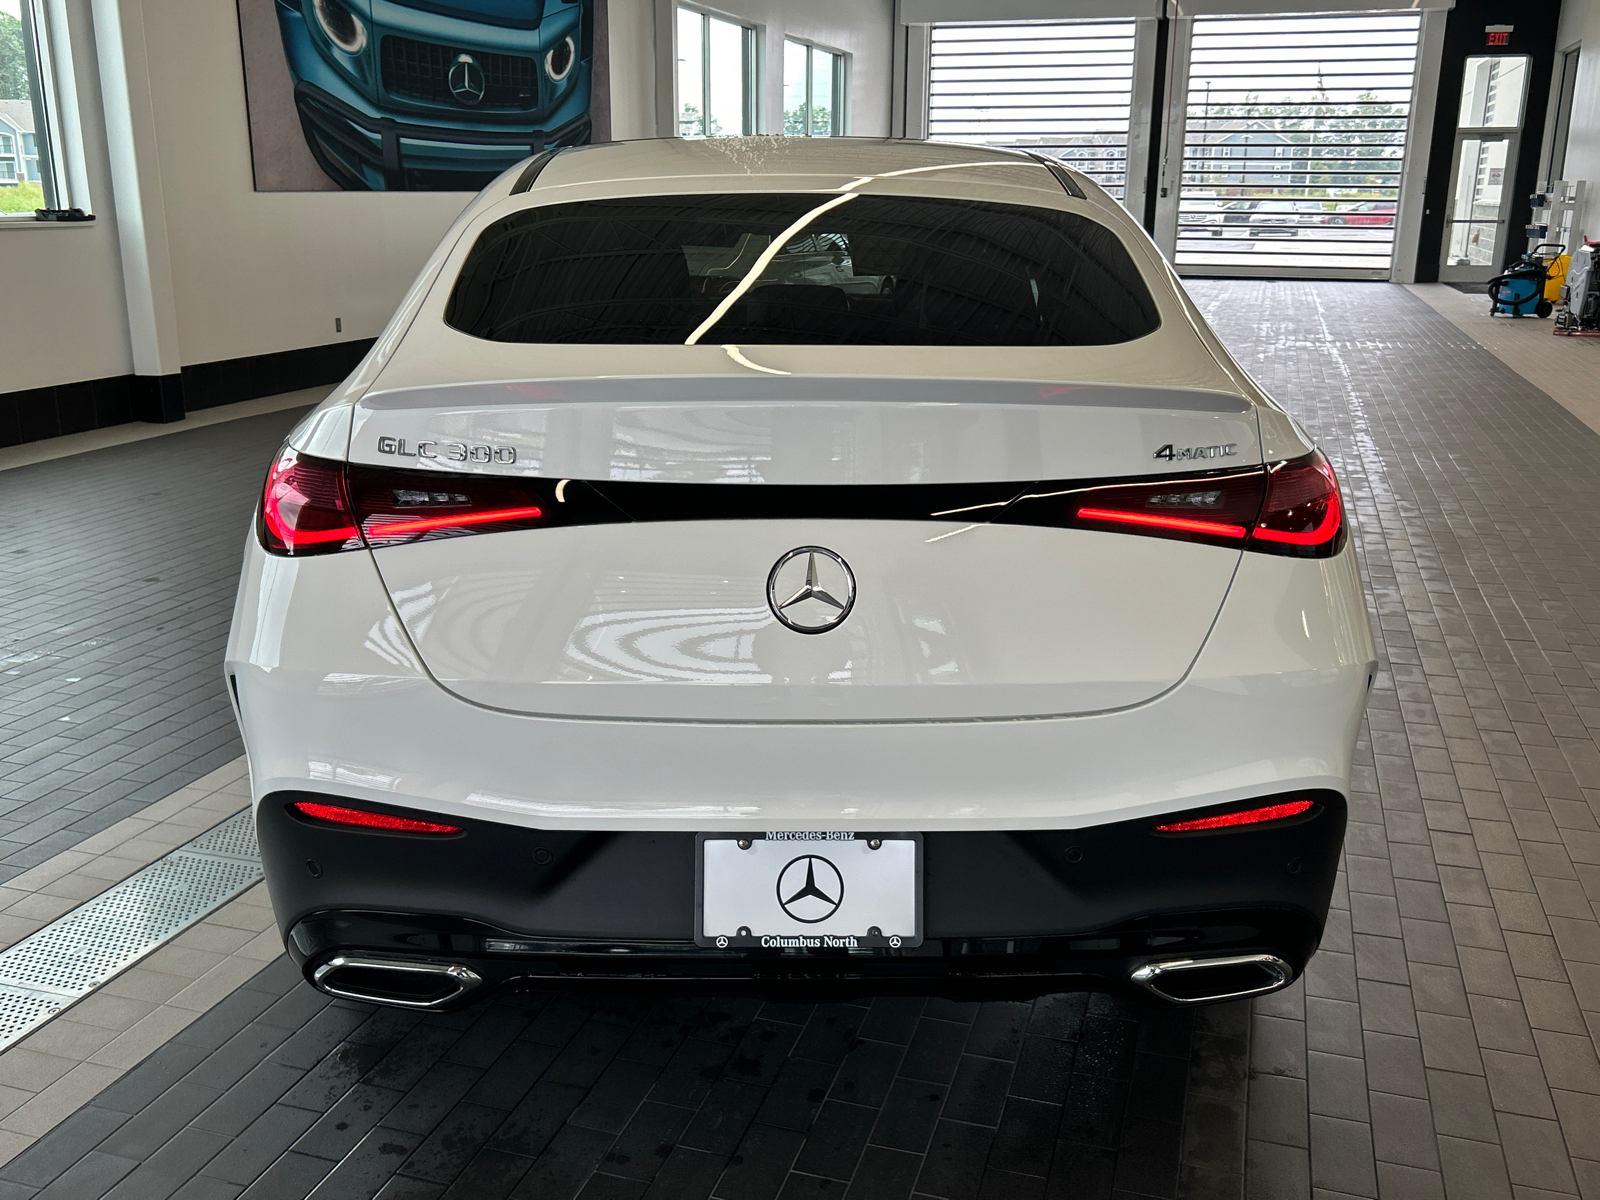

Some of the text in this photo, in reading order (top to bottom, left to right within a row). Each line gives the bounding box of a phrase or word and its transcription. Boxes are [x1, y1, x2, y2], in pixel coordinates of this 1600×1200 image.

[1488, 33, 1508, 45] EXIT
[378, 436, 516, 464] GLC 300
[1153, 444, 1238, 461] 4MATIC
[765, 831, 855, 840] Mercedes-Benz
[761, 936, 858, 947] Columbus North
